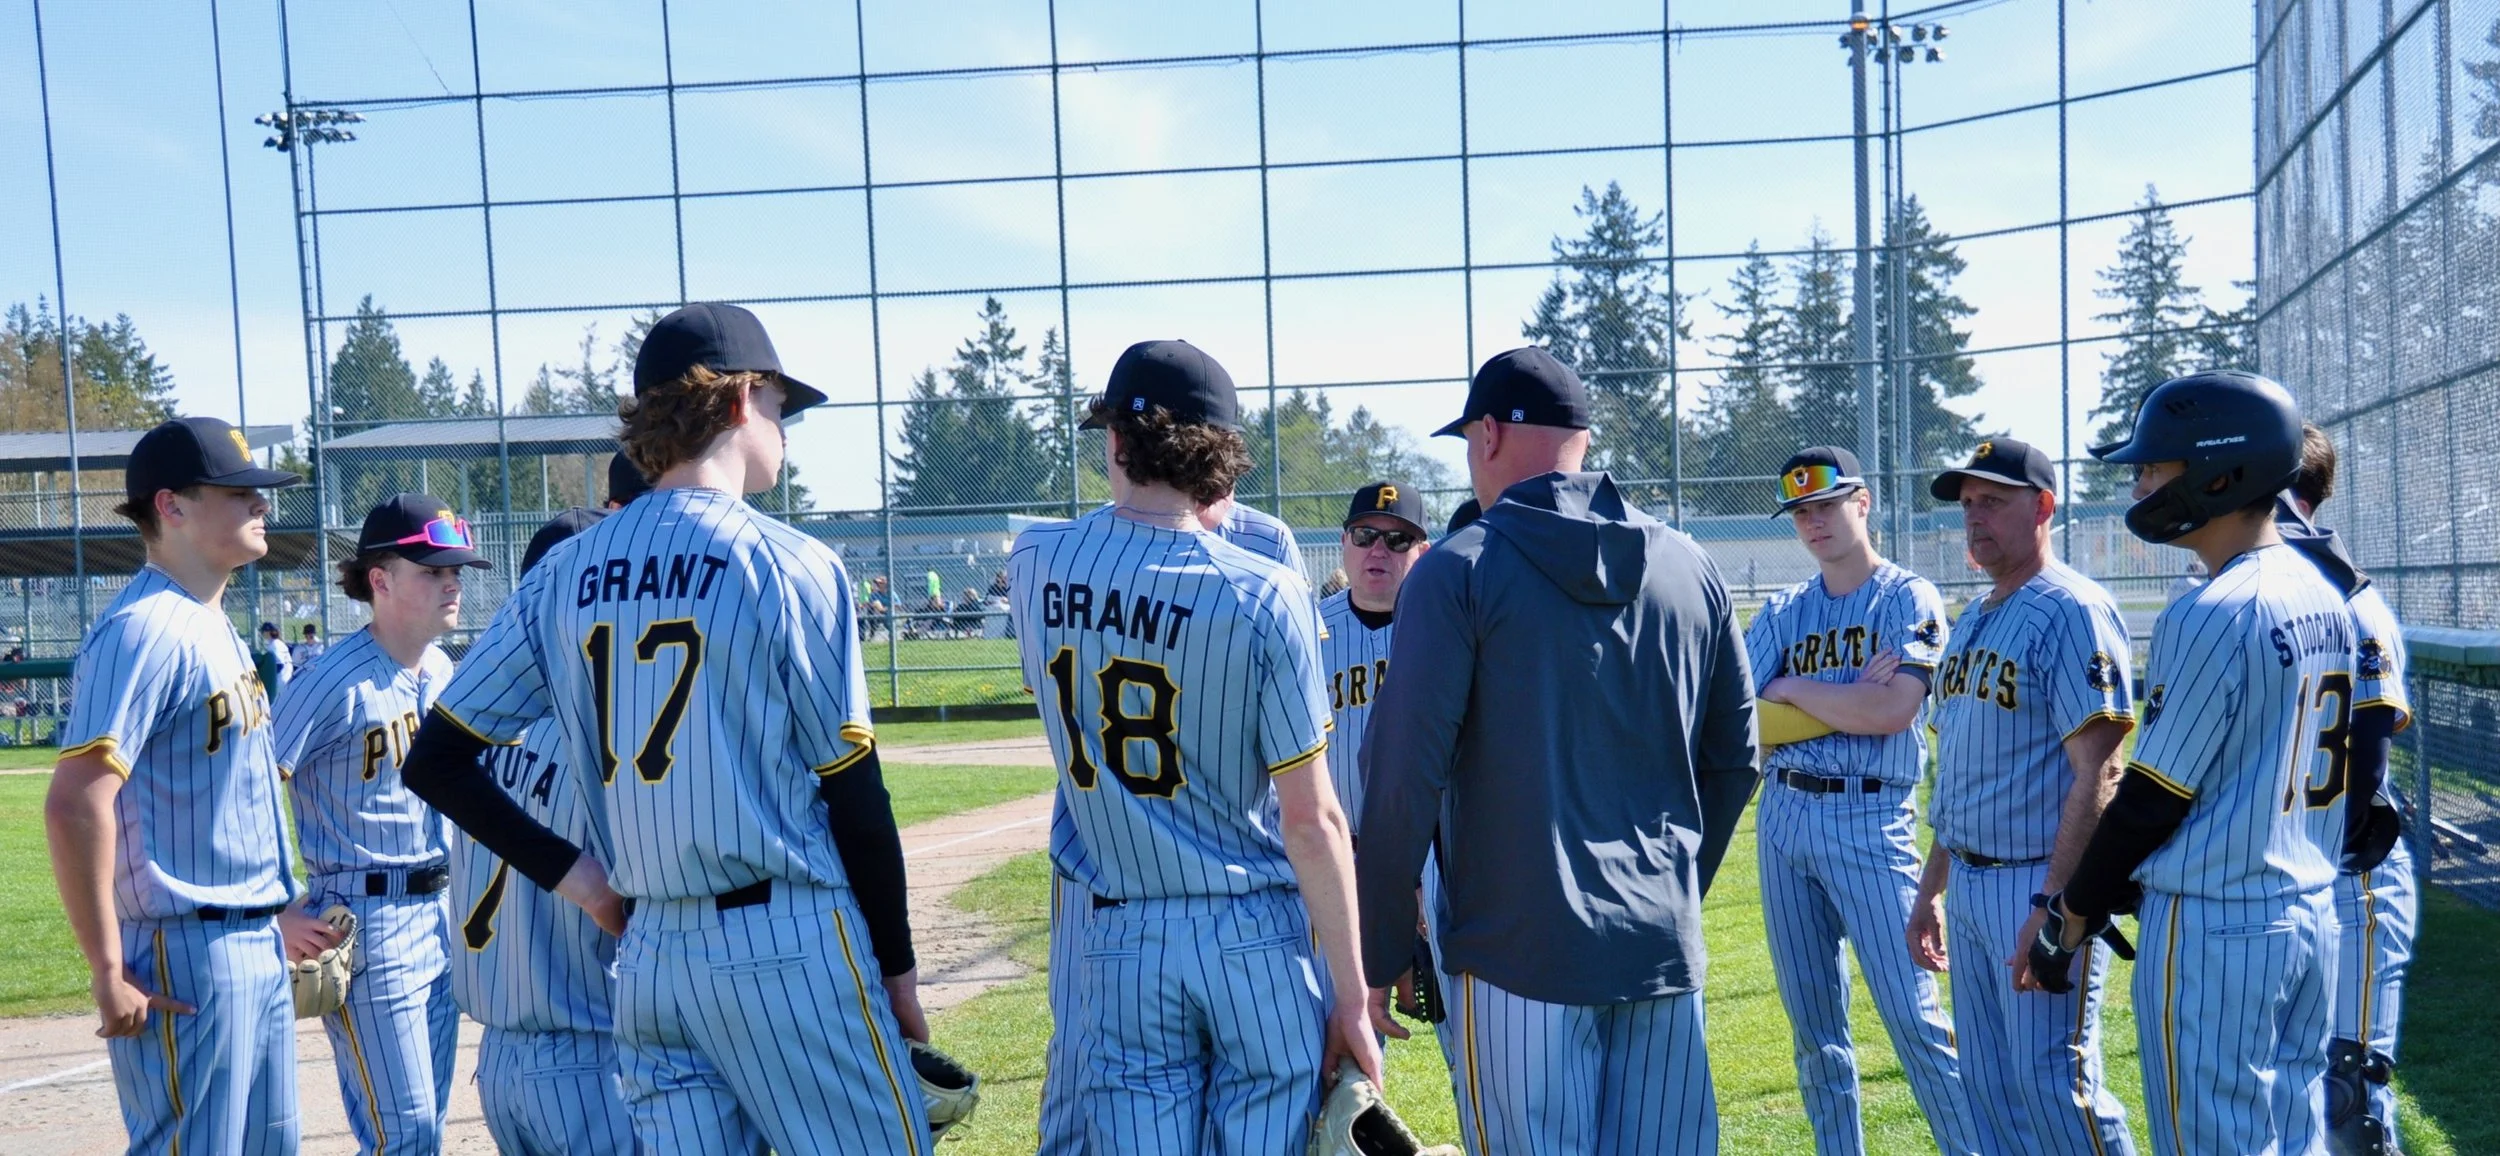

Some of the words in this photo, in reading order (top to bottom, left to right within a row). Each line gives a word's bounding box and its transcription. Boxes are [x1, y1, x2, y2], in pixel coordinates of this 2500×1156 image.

[1376, 486, 1398, 510] P
[577, 554, 728, 609] GRANT
[1042, 582, 1194, 651] GRANT
[582, 616, 703, 786] 17
[1048, 645, 1187, 799] 18
[2282, 670, 2351, 815] 13
